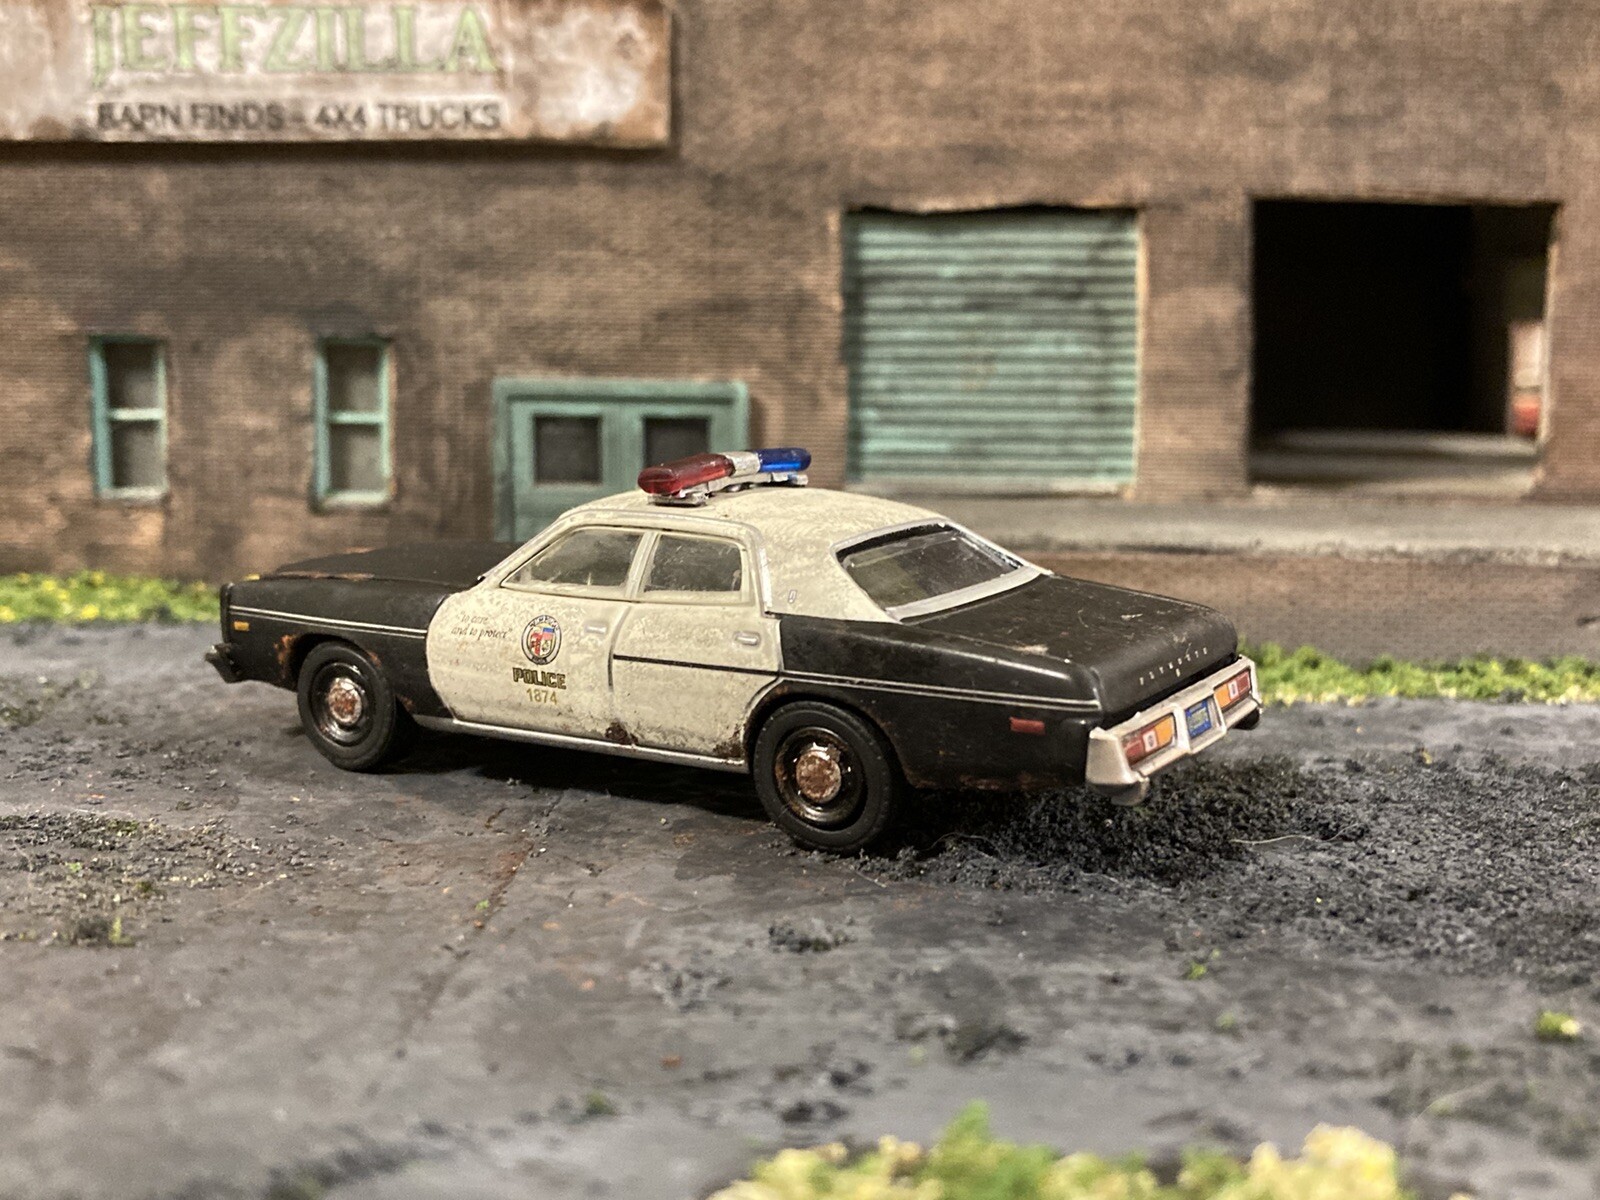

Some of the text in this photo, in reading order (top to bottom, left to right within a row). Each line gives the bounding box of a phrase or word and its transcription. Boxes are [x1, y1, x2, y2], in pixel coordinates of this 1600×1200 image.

[98, 102, 181, 130] BARN
[190, 103, 285, 130] FINDS
[376, 102, 501, 130] TRUCKS
[512, 667, 567, 690] POLICE
[526, 687, 558, 705] 1874
